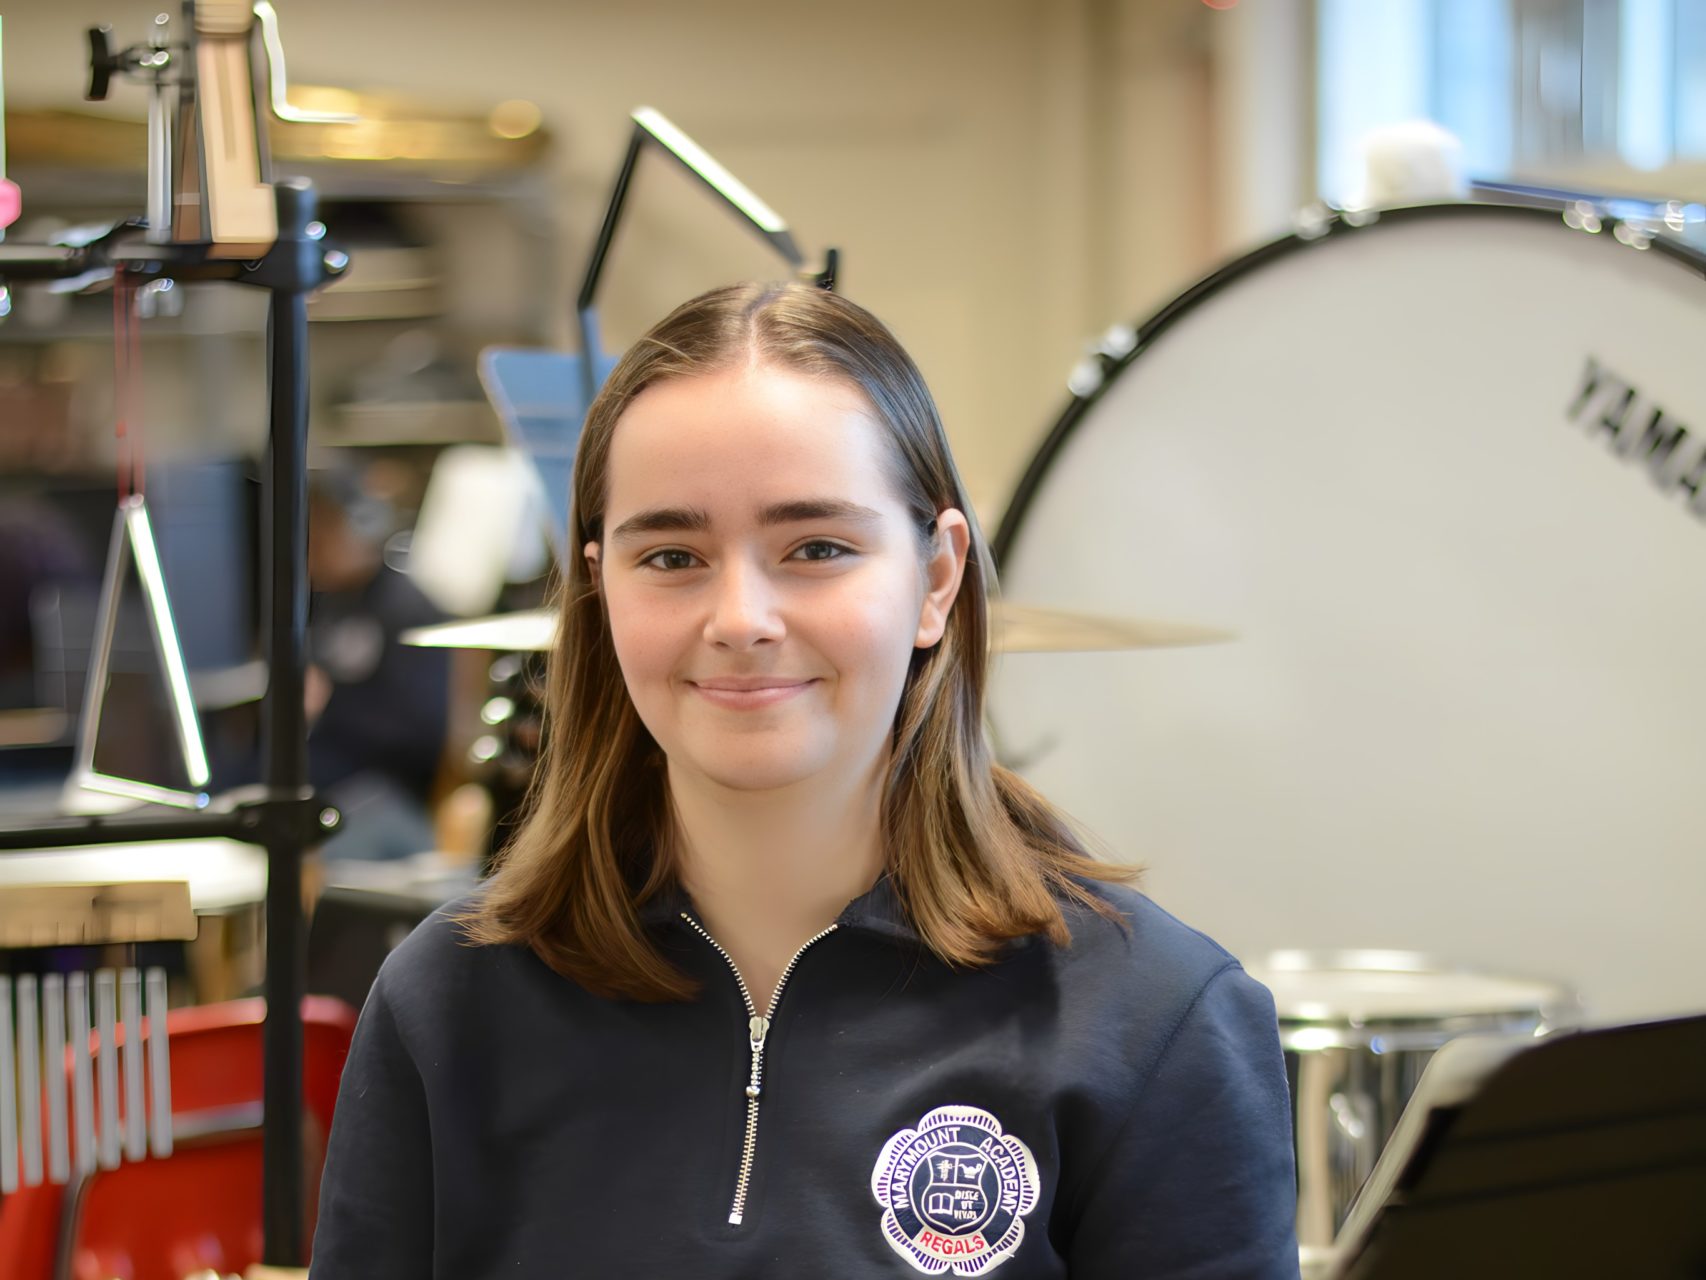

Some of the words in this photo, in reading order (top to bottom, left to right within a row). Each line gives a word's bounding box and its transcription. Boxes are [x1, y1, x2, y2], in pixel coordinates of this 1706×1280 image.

[892, 1127, 960, 1209] MARYMOUNT
[979, 1137, 1019, 1215] ACADEMY
[961, 1201, 974, 1210] UT
[920, 1231, 984, 1254] REGALS
